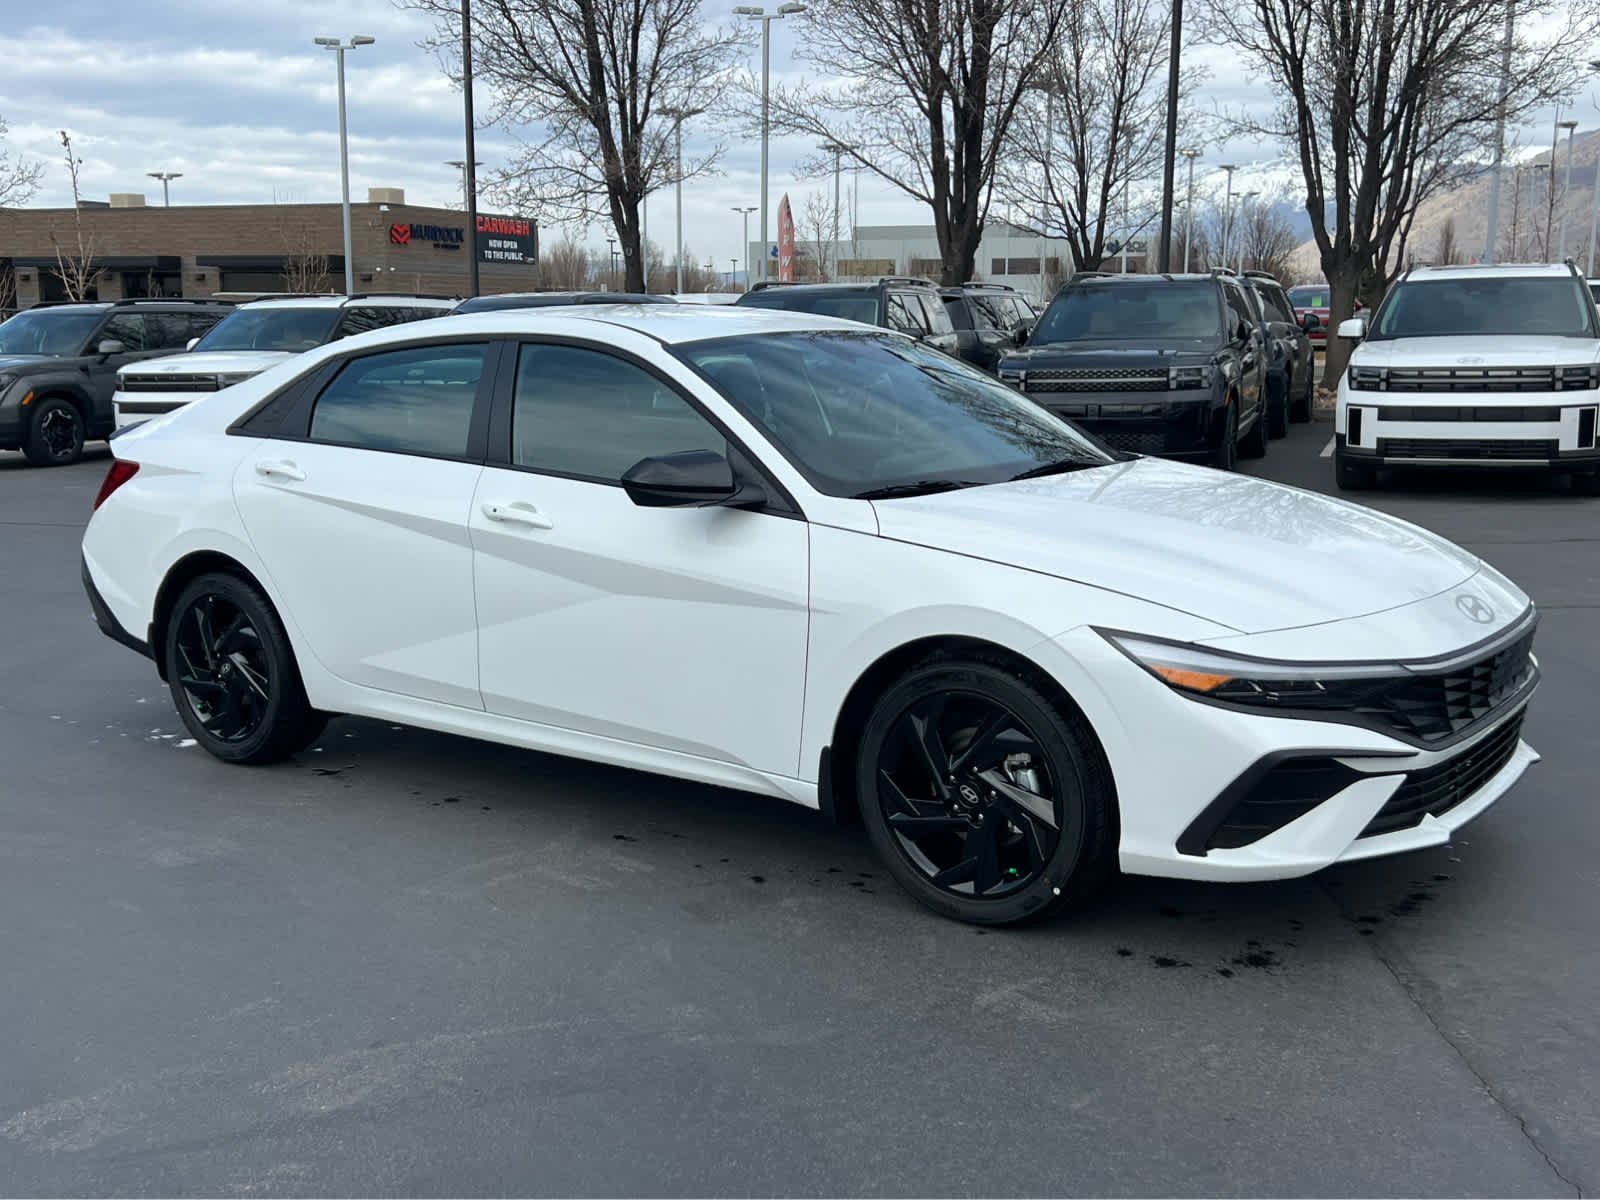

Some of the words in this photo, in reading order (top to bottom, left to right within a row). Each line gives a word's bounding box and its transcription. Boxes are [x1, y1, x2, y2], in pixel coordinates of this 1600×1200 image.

[411, 224, 464, 241] MURDOCK
[476, 215, 529, 236] CARWASH
[488, 239, 502, 248] NOW
[503, 240, 518, 249] OPEN
[484, 250, 492, 259] TO
[493, 251, 503, 259] THE
[504, 251, 523, 261] PUBLIC
